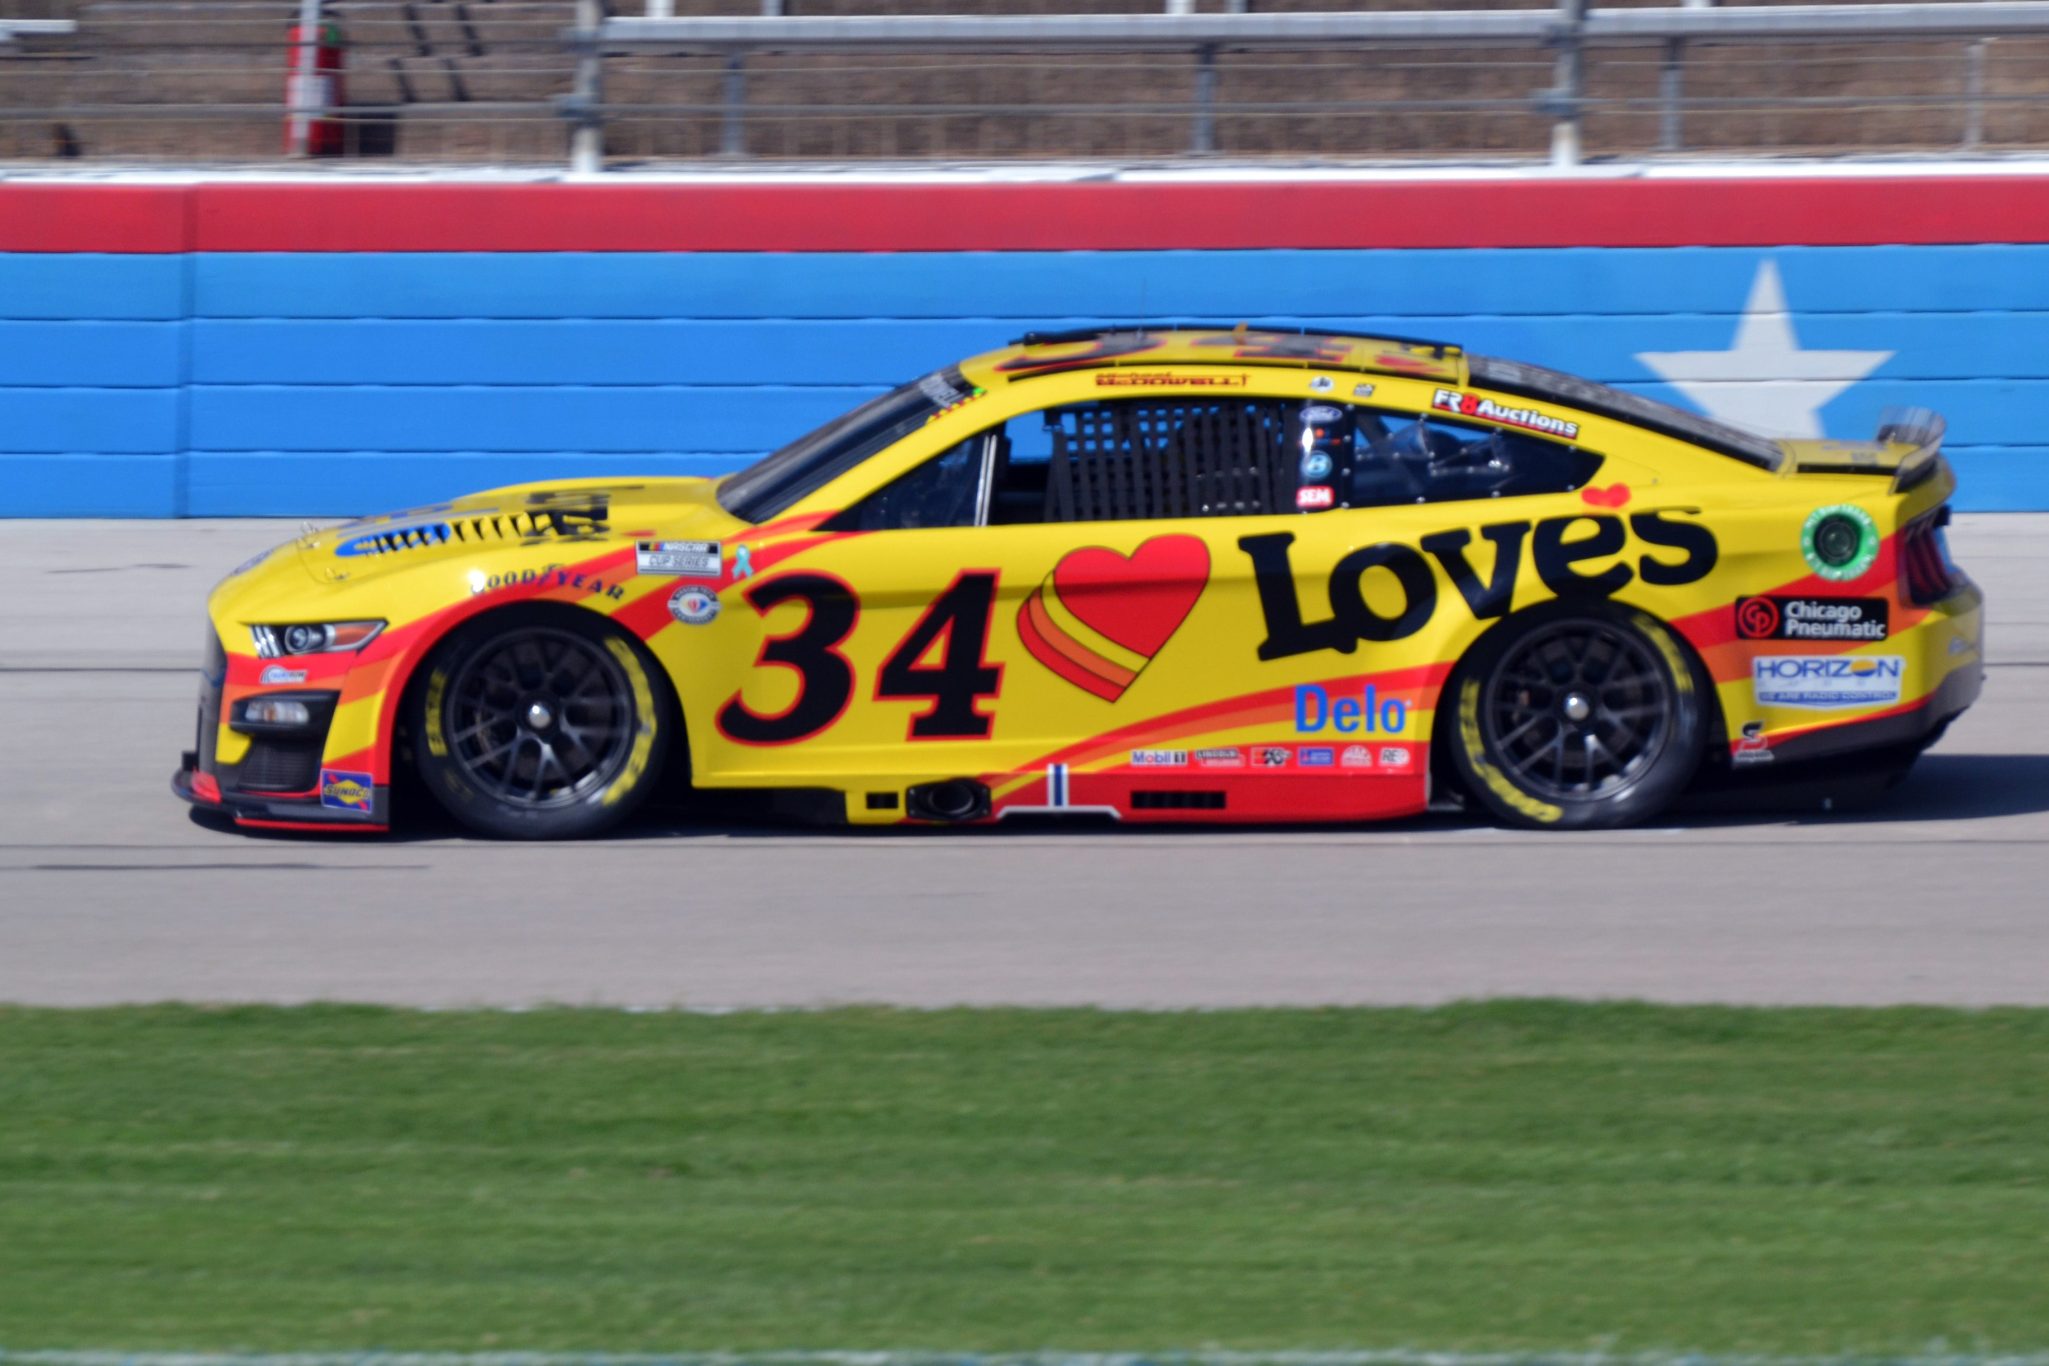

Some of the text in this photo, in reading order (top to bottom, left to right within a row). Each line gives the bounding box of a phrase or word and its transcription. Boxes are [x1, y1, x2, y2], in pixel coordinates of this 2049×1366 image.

[1300, 487, 1332, 504] SEM
[648, 555, 672, 567] CUP
[1785, 601, 1863, 622] Chicago
[1785, 619, 1886, 638] Pneumatic
[714, 568, 1006, 747] 34
[1294, 684, 1406, 733] Delo
[1132, 750, 1171, 763] Mobil
